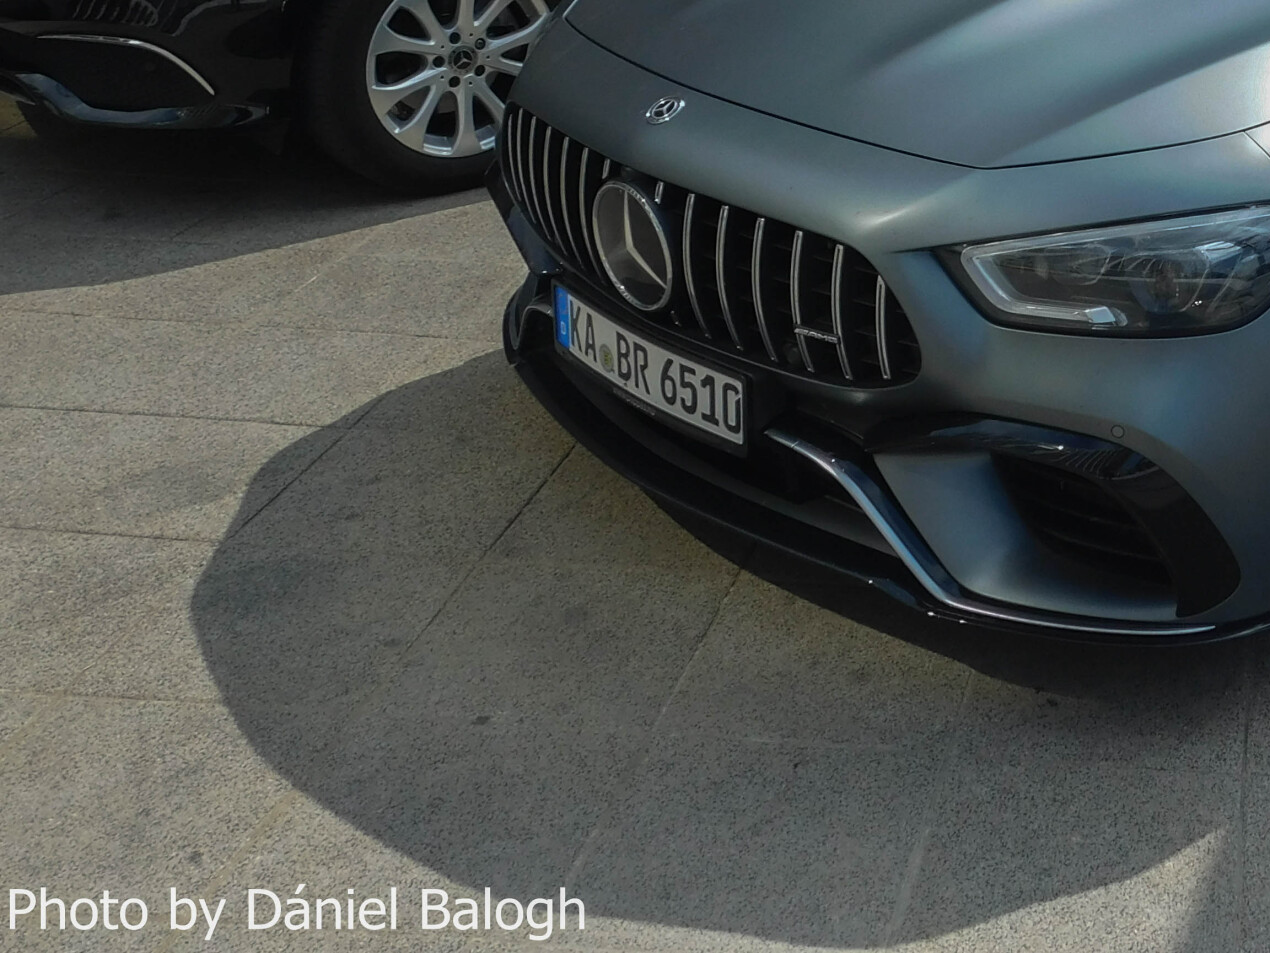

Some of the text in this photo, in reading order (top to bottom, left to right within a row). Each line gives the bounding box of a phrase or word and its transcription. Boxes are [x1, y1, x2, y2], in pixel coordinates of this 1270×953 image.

[570, 299, 598, 363] KA
[615, 330, 651, 396] BR
[660, 358, 741, 435] 6510
